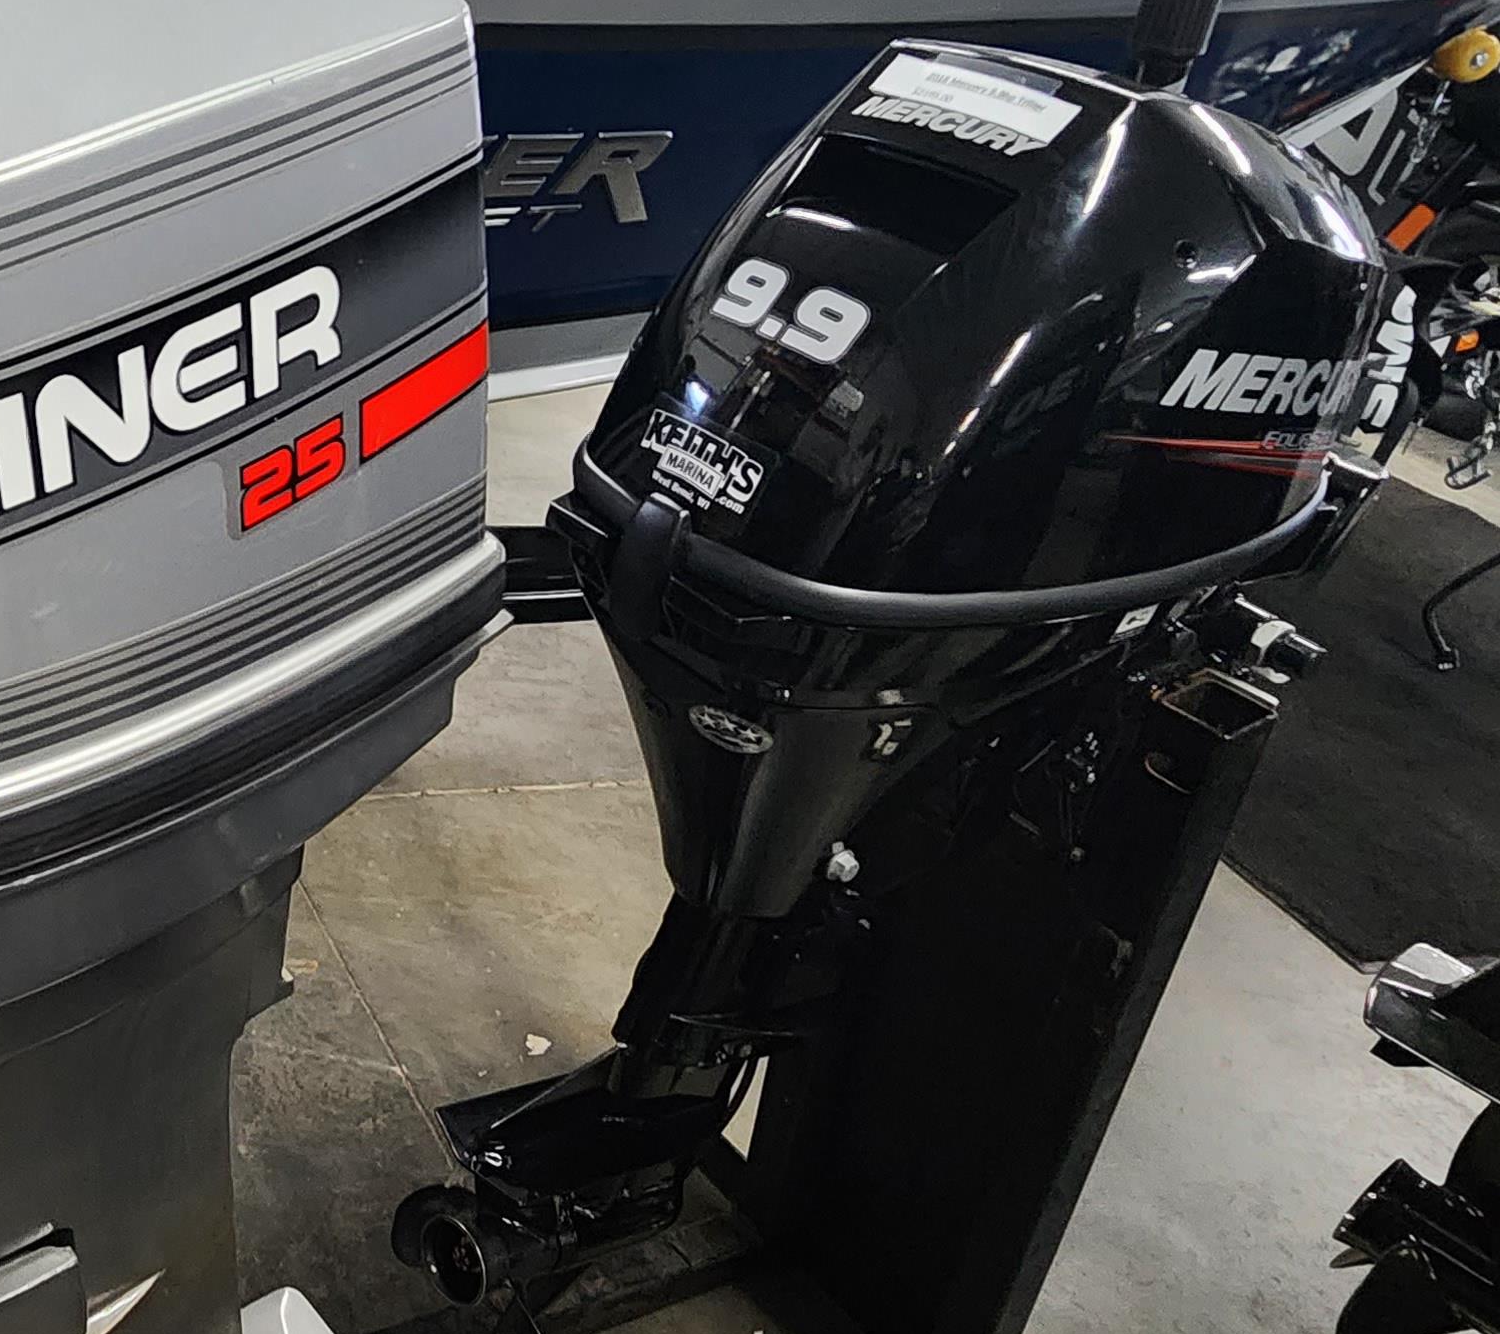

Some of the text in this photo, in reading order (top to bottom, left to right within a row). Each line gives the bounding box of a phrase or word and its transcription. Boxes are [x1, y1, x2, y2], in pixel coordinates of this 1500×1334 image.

[852, 96, 1047, 157] MERCURY
[710, 258, 871, 364] 9.9
[1160, 349, 1364, 416] MERCUR
[240, 412, 346, 532] 25
[641, 409, 764, 502] KEITH'S
[666, 453, 715, 490] MARINA
